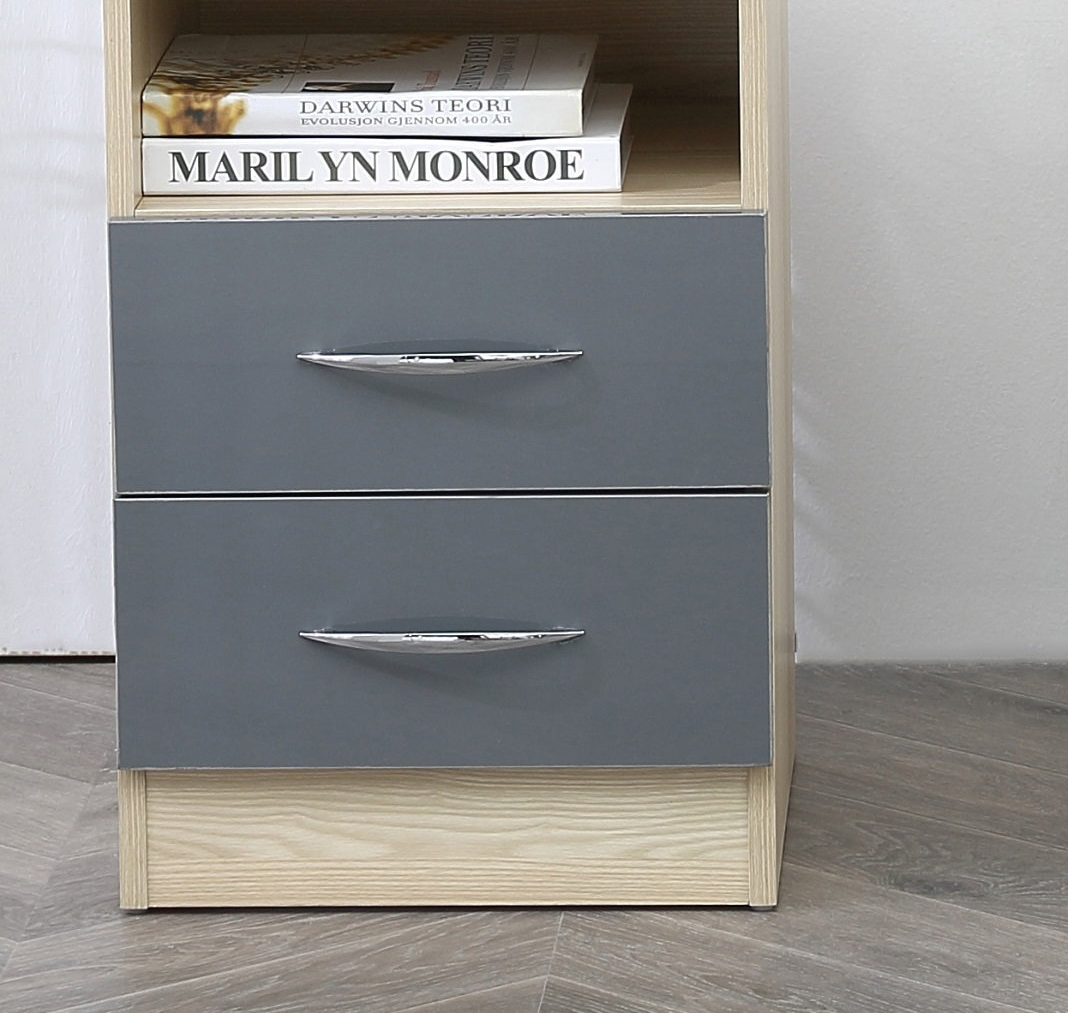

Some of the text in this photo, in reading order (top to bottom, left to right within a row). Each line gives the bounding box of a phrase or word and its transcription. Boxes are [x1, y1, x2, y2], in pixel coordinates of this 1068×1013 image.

[299, 99, 512, 114] DARWINS TEORI
[301, 114, 512, 126] EVOLUSJON GJENNOM 400 ÅR
[391, 149, 585, 182] MONROE
